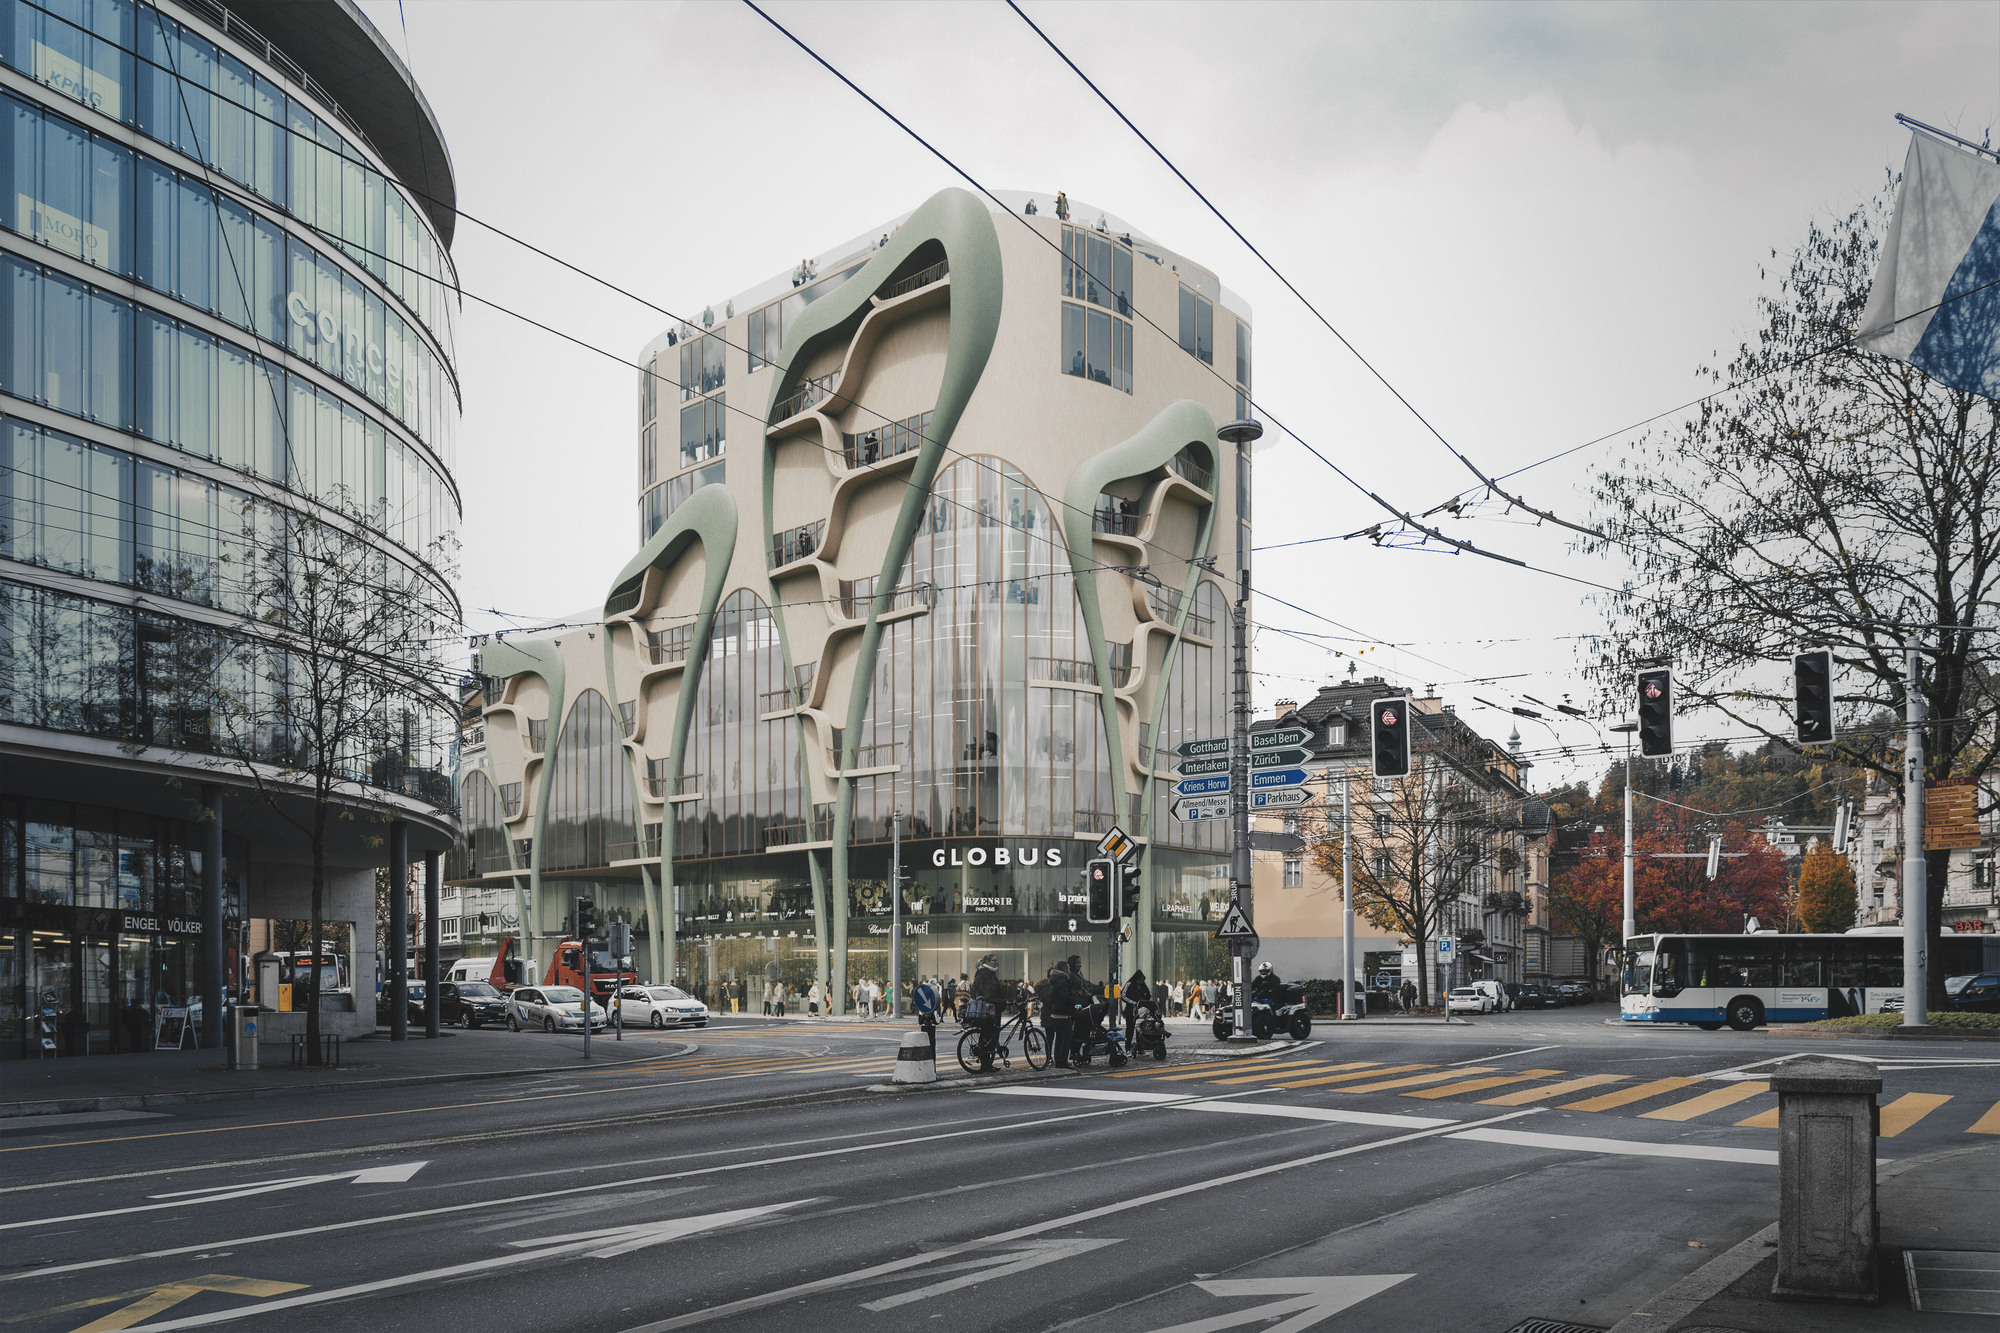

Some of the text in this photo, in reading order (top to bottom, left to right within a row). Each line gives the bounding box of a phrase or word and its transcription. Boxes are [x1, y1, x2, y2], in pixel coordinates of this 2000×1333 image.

[50, 70, 103, 106] KPMG
[45, 216, 98, 249] MORO
[1253, 732, 1299, 747] Basel Bern
[1189, 739, 1227, 754] Gotthard
[1254, 754, 1281, 766] Zürich
[1662, 755, 1682, 764] D10
[1185, 760, 1227, 773] Interlaken
[1183, 779, 1227, 792] Kriens Horw
[1254, 774, 1287, 785] Emmen
[1936, 779, 1965, 787] HOTELS
[1181, 798, 1227, 809] Allmend/Messe
[1267, 792, 1300, 804] Parkhaus
[932, 847, 1062, 867] GLOBUS
[962, 897, 1013, 906] MIZENSIR
[124, 916, 161, 931] ENGEL
[906, 921, 930, 935] PIAGET
[968, 924, 1000, 935] swatch
[1955, 920, 1983, 931] BAR
